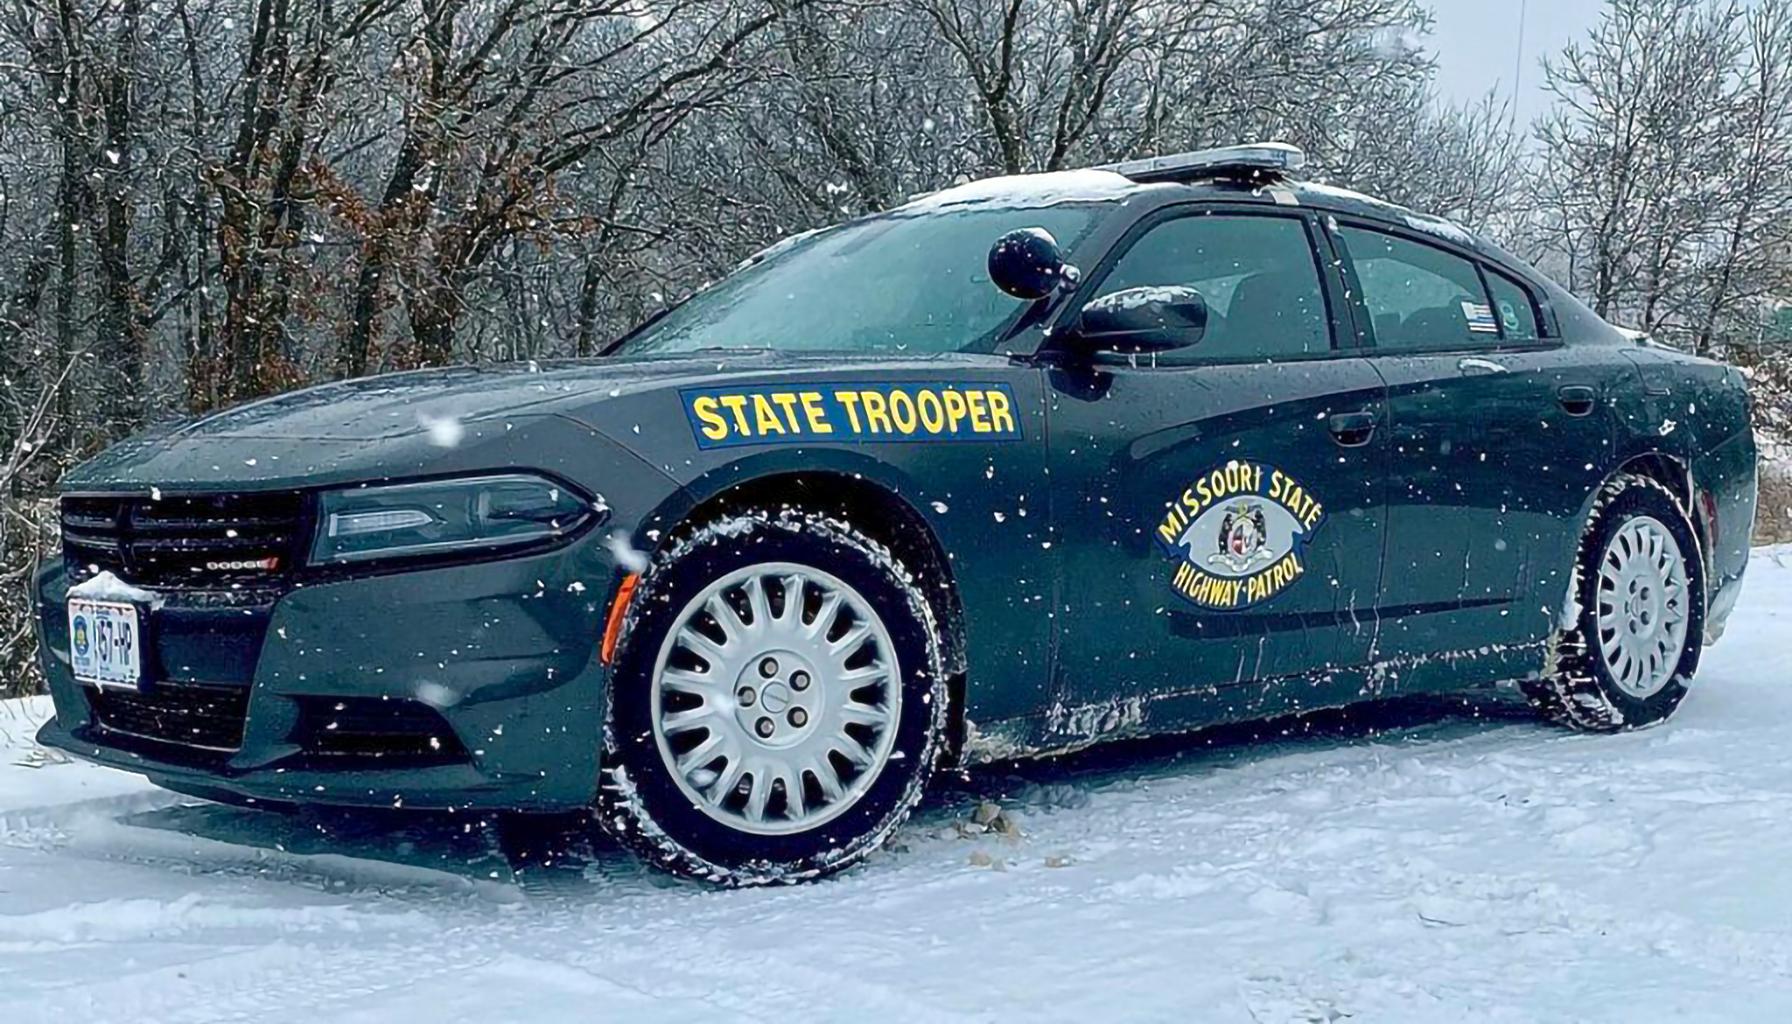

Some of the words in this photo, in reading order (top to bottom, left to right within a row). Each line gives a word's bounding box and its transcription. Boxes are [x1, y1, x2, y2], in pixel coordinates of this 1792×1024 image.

[693, 392, 833, 440] STATE
[835, 389, 1015, 435] TROOPER
[1158, 464, 1262, 545] MISSOURI
[1268, 469, 1322, 532] STATE
[1172, 560, 1243, 606] HIGHWAY
[1246, 552, 1304, 604] PATROL
